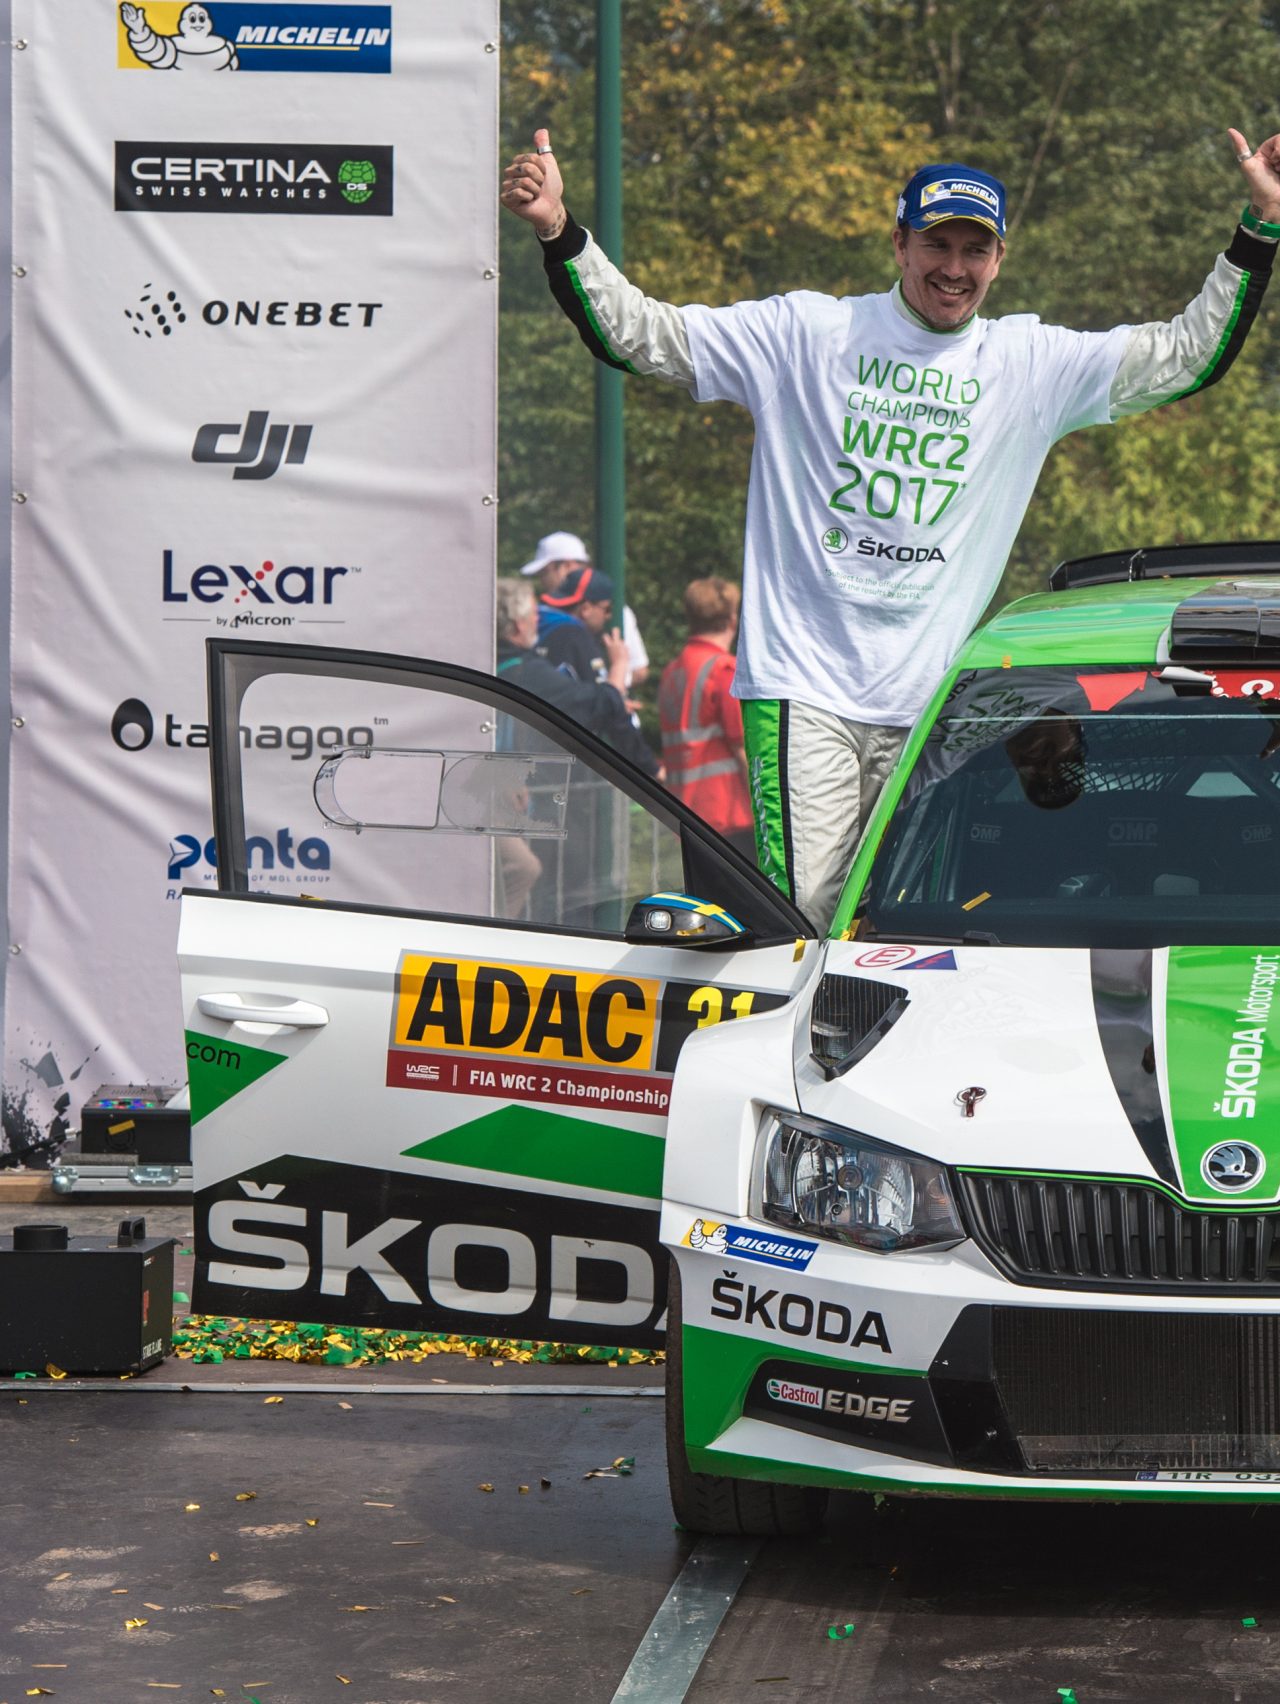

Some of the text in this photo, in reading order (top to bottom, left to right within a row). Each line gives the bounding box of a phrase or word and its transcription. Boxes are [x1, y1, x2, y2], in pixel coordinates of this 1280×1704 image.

[235, 26, 390, 46] MICHELIN
[131, 157, 331, 183] CERTINA
[136, 186, 327, 199] SWISS WATCHES
[346, 183, 368, 191] DS
[951, 183, 998, 206] MICHELIN
[202, 300, 383, 327] ONEBET
[858, 354, 981, 405] WORLD
[847, 391, 971, 428] CHAMPIONS
[842, 416, 969, 472] WRC2
[857, 536, 946, 562] ŠKODA
[163, 550, 348, 604] Lexar
[216, 616, 227, 627] by
[165, 713, 374, 761] taaggo
[1108, 822, 1158, 841] OMP
[406, 962, 646, 1063] ADAC
[186, 1043, 241, 1070] com
[406, 1063, 440, 1074] WRC
[1213, 1028, 1267, 1118] ŠKODA
[470, 1070, 668, 1108] FIA WRC 2 Championship
[207, 1180, 668, 1330] ŠKOD
[732, 1235, 814, 1261] MICHELIN
[710, 1270, 893, 1354] ŠKODA
[781, 1384, 916, 1424] Castrol EDGE
